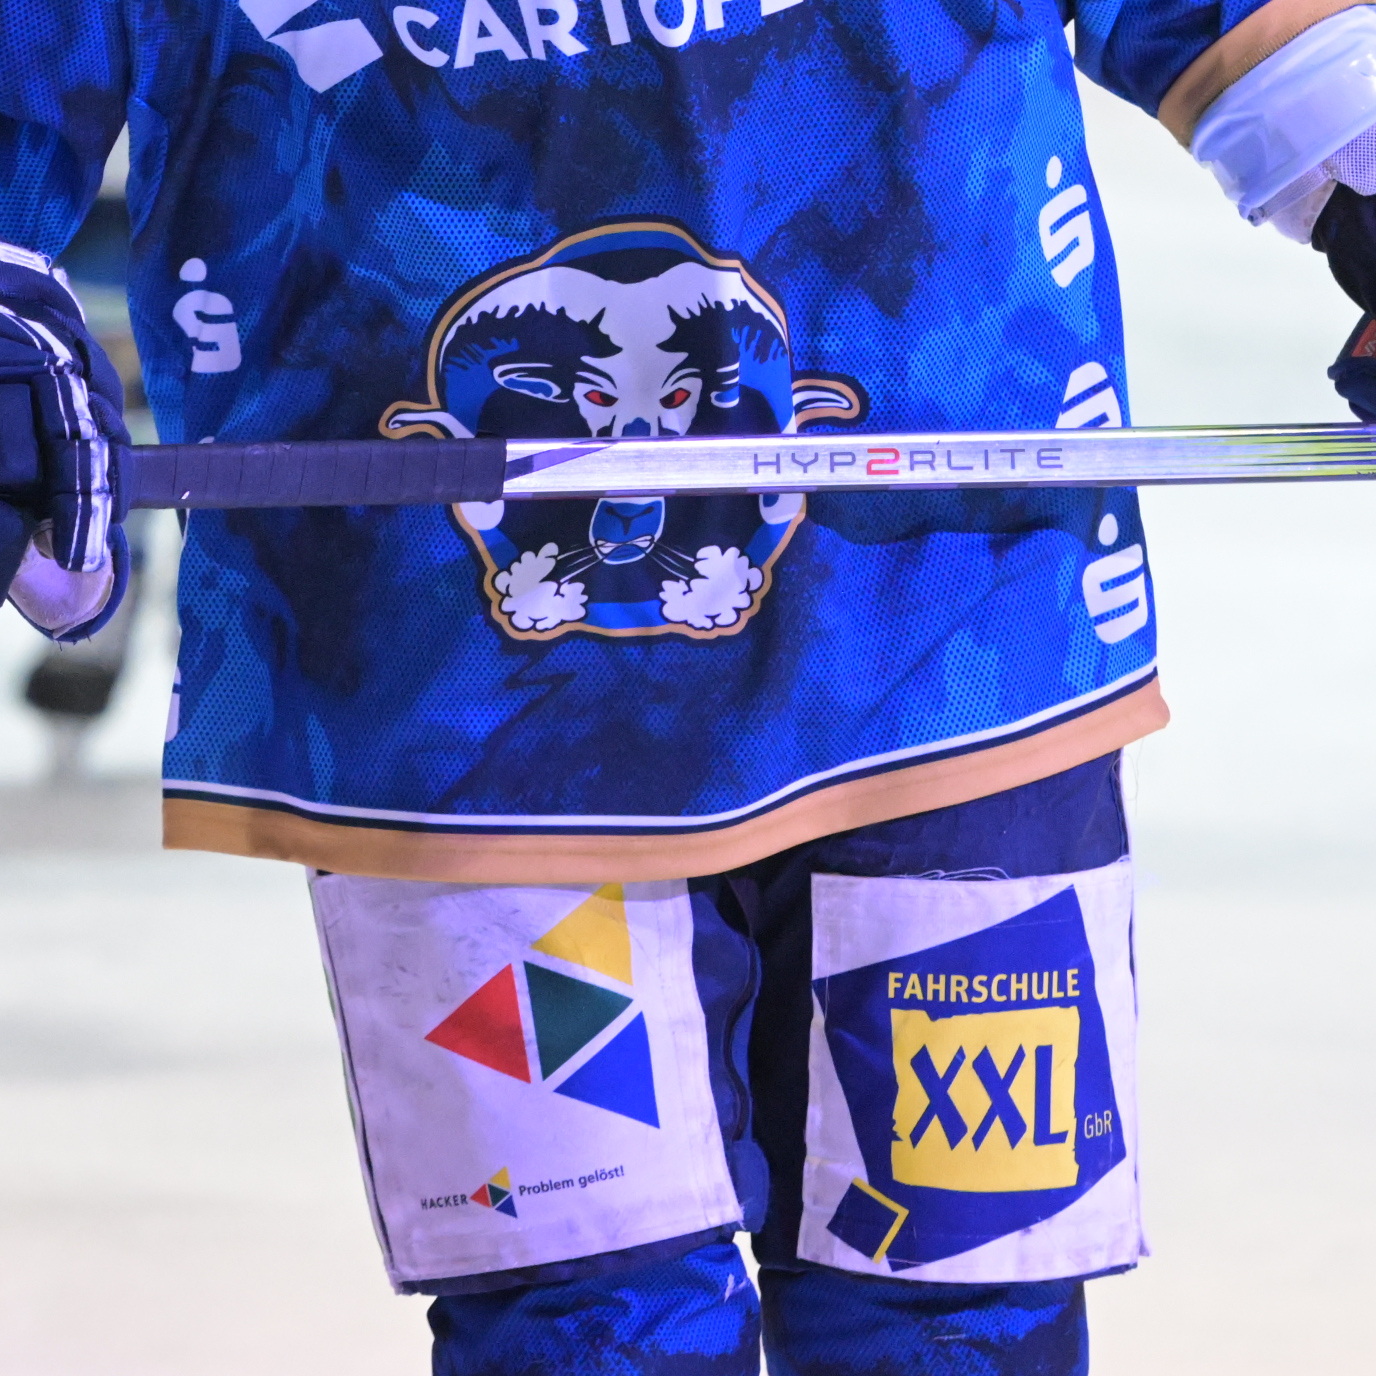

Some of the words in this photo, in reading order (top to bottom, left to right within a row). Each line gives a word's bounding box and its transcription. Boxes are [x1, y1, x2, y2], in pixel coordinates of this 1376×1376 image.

[887, 968, 1081, 1004] FAHRSCHULE
[909, 1043, 1070, 1152] XXL
[1083, 1109, 1114, 1140] GbR
[420, 1192, 469, 1211] HACKER
[517, 1177, 575, 1197] Problem
[577, 1164, 626, 1189] gelöst!
